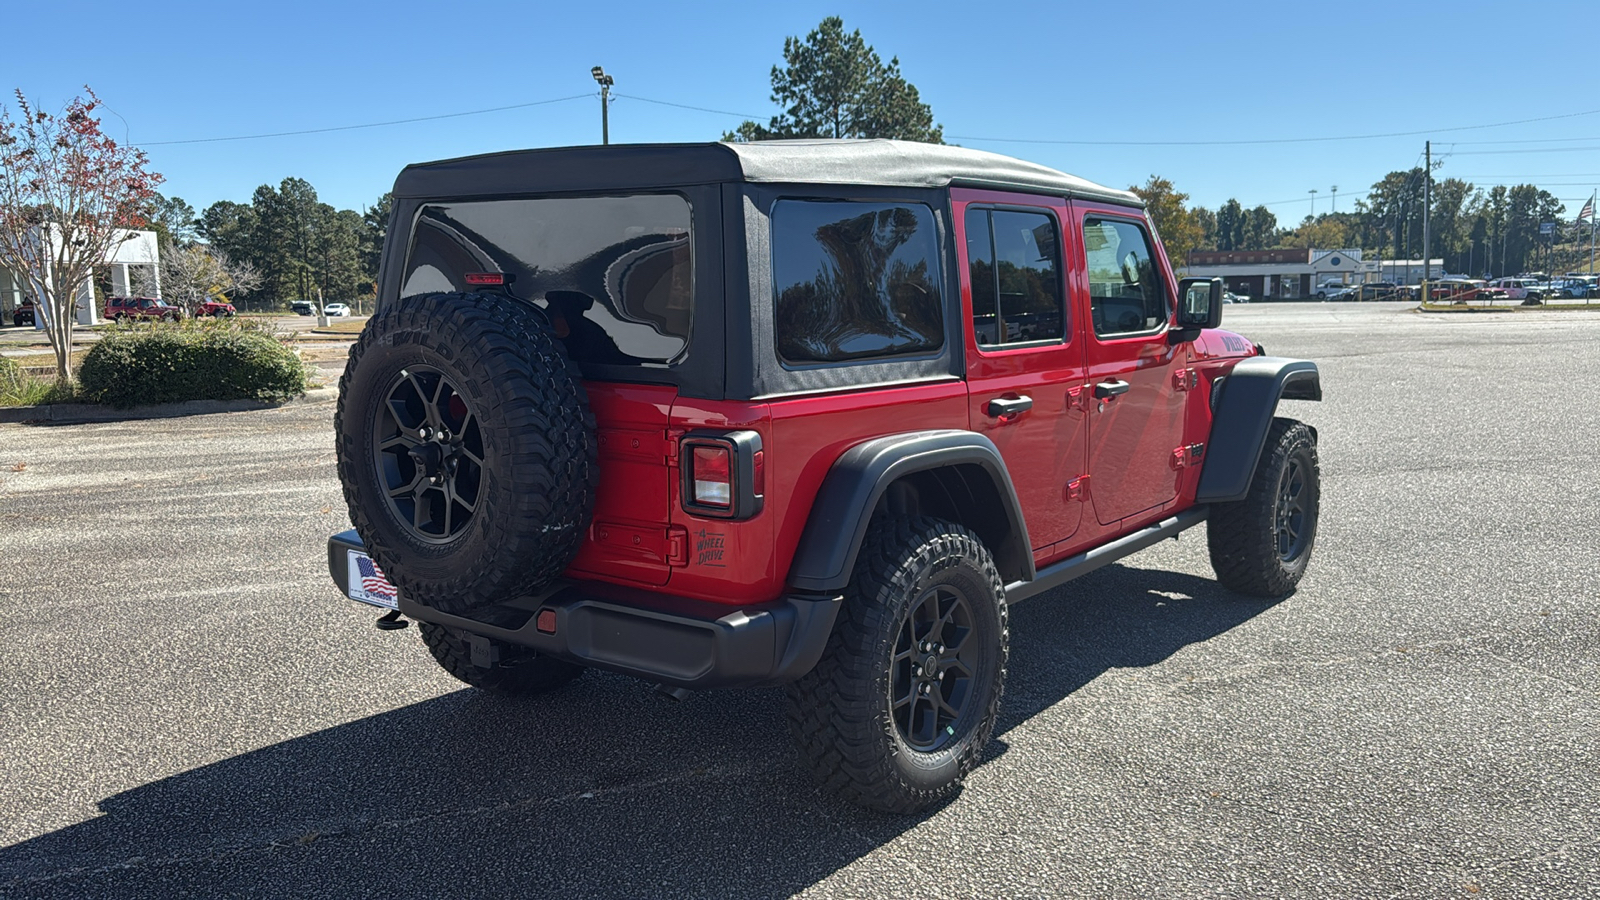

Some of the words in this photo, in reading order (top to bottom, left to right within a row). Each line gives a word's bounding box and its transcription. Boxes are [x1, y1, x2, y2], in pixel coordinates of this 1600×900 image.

[392, 331, 497, 453] WILDPEAK
[699, 528, 706, 538] 4
[697, 538, 724, 552] WHEEL
[698, 550, 724, 565] DRIVE
